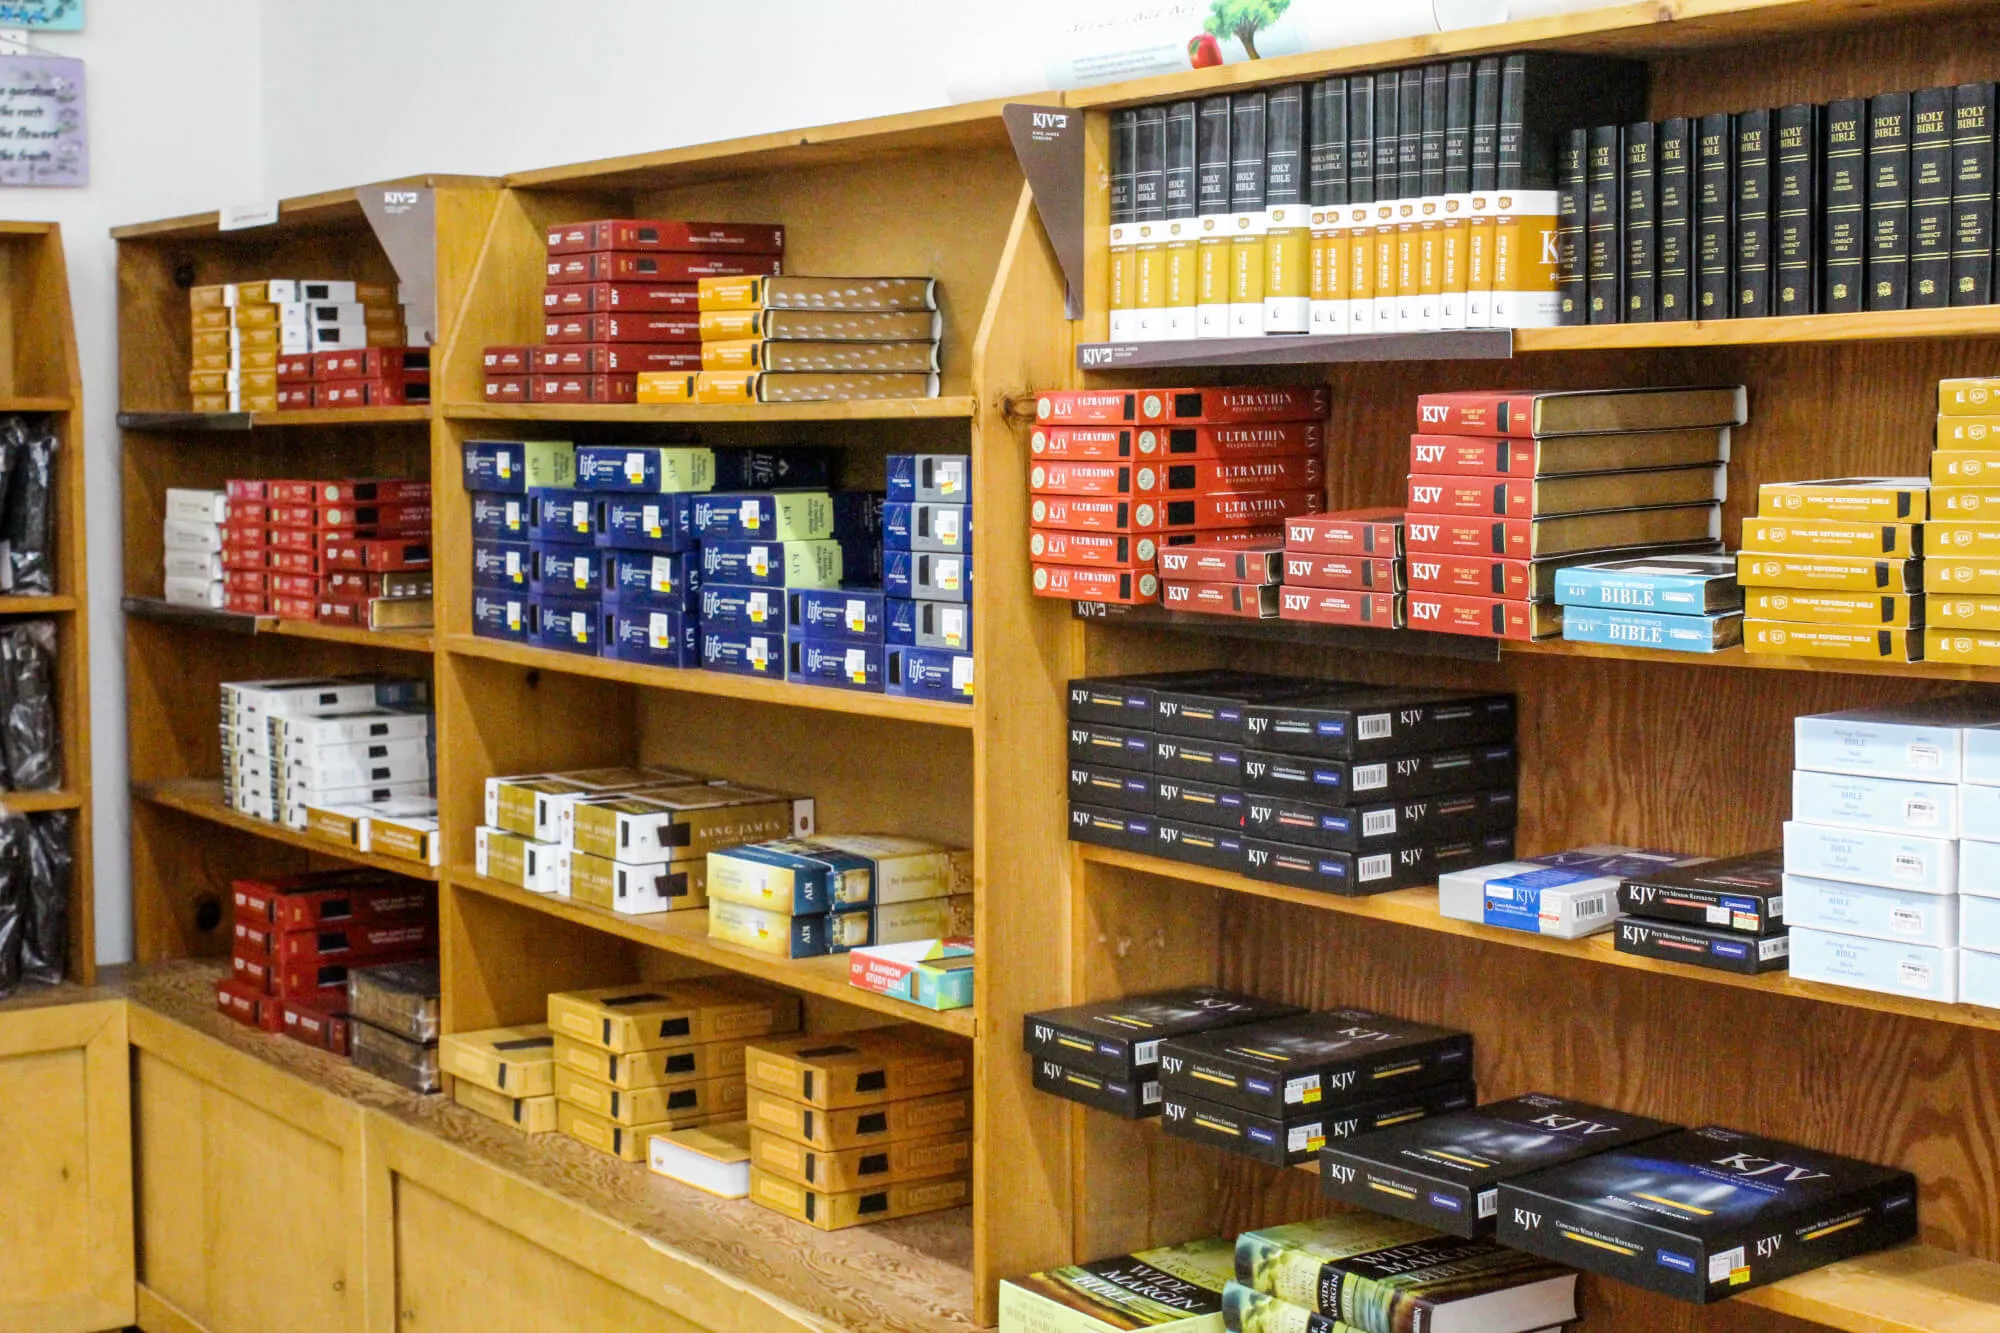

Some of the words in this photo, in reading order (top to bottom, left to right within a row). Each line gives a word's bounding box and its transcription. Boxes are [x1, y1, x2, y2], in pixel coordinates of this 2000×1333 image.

[1032, 113, 1056, 128] KJV
[1917, 111, 1944, 123] HOLY
[1957, 106, 1986, 119] HOLY
[1831, 121, 1856, 132] HOLY
[1874, 116, 1901, 128] HOLY
[1917, 122, 1944, 134] BIBLE
[1957, 118, 1985, 129] BIBLE
[1780, 127, 1803, 138] HOLY
[1831, 132, 1856, 143] BIBLE
[1874, 127, 1901, 138] BIBLE
[1780, 137, 1802, 148] BIBLE
[1236, 172, 1255, 181] HOLY
[1272, 164, 1289, 173] HOLY
[1203, 175, 1220, 184] HOLY
[1235, 183, 1255, 191] BIBLE
[1270, 174, 1290, 183] BIBLE
[1201, 185, 1220, 193] BIBLE
[1083, 348, 1102, 365] KJV
[1078, 396, 1120, 406] ULTRATHIN
[1223, 393, 1292, 406] ULTRATHIN
[1421, 405, 1450, 423] KJV
[1072, 432, 1115, 441] ULTRATHIN
[1218, 429, 1286, 442] ULTRATHIN
[1416, 445, 1447, 463] KJV
[580, 455, 597, 480] life
[1072, 468, 1114, 477] ULTRATHIN
[1216, 463, 1285, 477] ULTRATHIN
[1413, 486, 1443, 504] KJV
[1072, 502, 1114, 512] ULTRATHIN
[1216, 499, 1286, 512] ULTRATHIN
[680, 510, 689, 532] KJV
[696, 503, 712, 530] life
[1072, 536, 1113, 547] ULTRATHIN
[1290, 527, 1315, 542] KJV
[1409, 524, 1441, 542] KJV
[705, 547, 721, 575] life
[1163, 555, 1189, 570] KJV
[1288, 561, 1313, 576] KJV
[1074, 571, 1116, 583] ULTRATHIN
[1411, 562, 1442, 580] KJV
[1168, 586, 1190, 601] KJV
[1285, 594, 1311, 610] KJV
[1600, 587, 1655, 606] BIBLE
[704, 592, 720, 619] life
[808, 600, 823, 624] life
[1078, 601, 1096, 616] KJV
[1412, 601, 1442, 620] KJV
[1608, 623, 1663, 643] BIBLE
[705, 635, 722, 663] life
[807, 648, 823, 672] life
[908, 659, 926, 684] life
[1072, 690, 1089, 704] KJV
[1160, 701, 1178, 717] KJV
[1248, 717, 1268, 734] KJV
[1400, 709, 1422, 727] KJV
[1072, 730, 1089, 745] KJV
[1158, 743, 1176, 759] KJV
[1246, 762, 1266, 778] KJV
[1397, 758, 1420, 776] KJV
[1072, 770, 1089, 785] KJV
[1160, 784, 1179, 800] KJV
[1073, 811, 1090, 826] KJV
[1251, 806, 1272, 823] KJV
[1405, 803, 1427, 821] KJV
[700, 826, 732, 837] KING
[740, 821, 780, 835] JAMES
[1160, 827, 1178, 843] KJV
[1248, 849, 1268, 866] KJV
[1400, 848, 1422, 866] KJV
[804, 882, 813, 900] KJV
[1516, 889, 1537, 905] KJV
[1630, 885, 1656, 905] KJV
[1690, 893, 1717, 902] REFERENCE
[802, 926, 810, 943] KJV
[1623, 925, 1649, 945] KJV
[1663, 932, 1681, 940] MINION
[1682, 935, 1708, 945] REFERENCE
[869, 962, 902, 978] RAINBOW
[866, 971, 887, 989] STUDY
[1035, 1024, 1054, 1043] KJV
[1043, 1061, 1062, 1080] KJV
[1162, 1056, 1183, 1075] KJV
[1332, 1071, 1356, 1091] KJV
[1165, 1102, 1186, 1121] KJV
[1334, 1118, 1359, 1139] KJV
[1529, 1113, 1622, 1135] KJV
[1332, 1163, 1356, 1184] KJV
[1711, 1152, 1831, 1182] KJV
[1514, 1207, 1542, 1231] KJV
[1615, 1236, 1644, 1251] REFERENCE
[1756, 1233, 1782, 1258] KJV
[1352, 1244, 1431, 1264] WIDE
[1129, 1264, 1197, 1294] WIDE
[1071, 1276, 1137, 1305] BIBLE
[1100, 1269, 1207, 1310] MARGIN
[1322, 1279, 1330, 1307] WIDE
[1329, 1273, 1340, 1318] MARGIN
